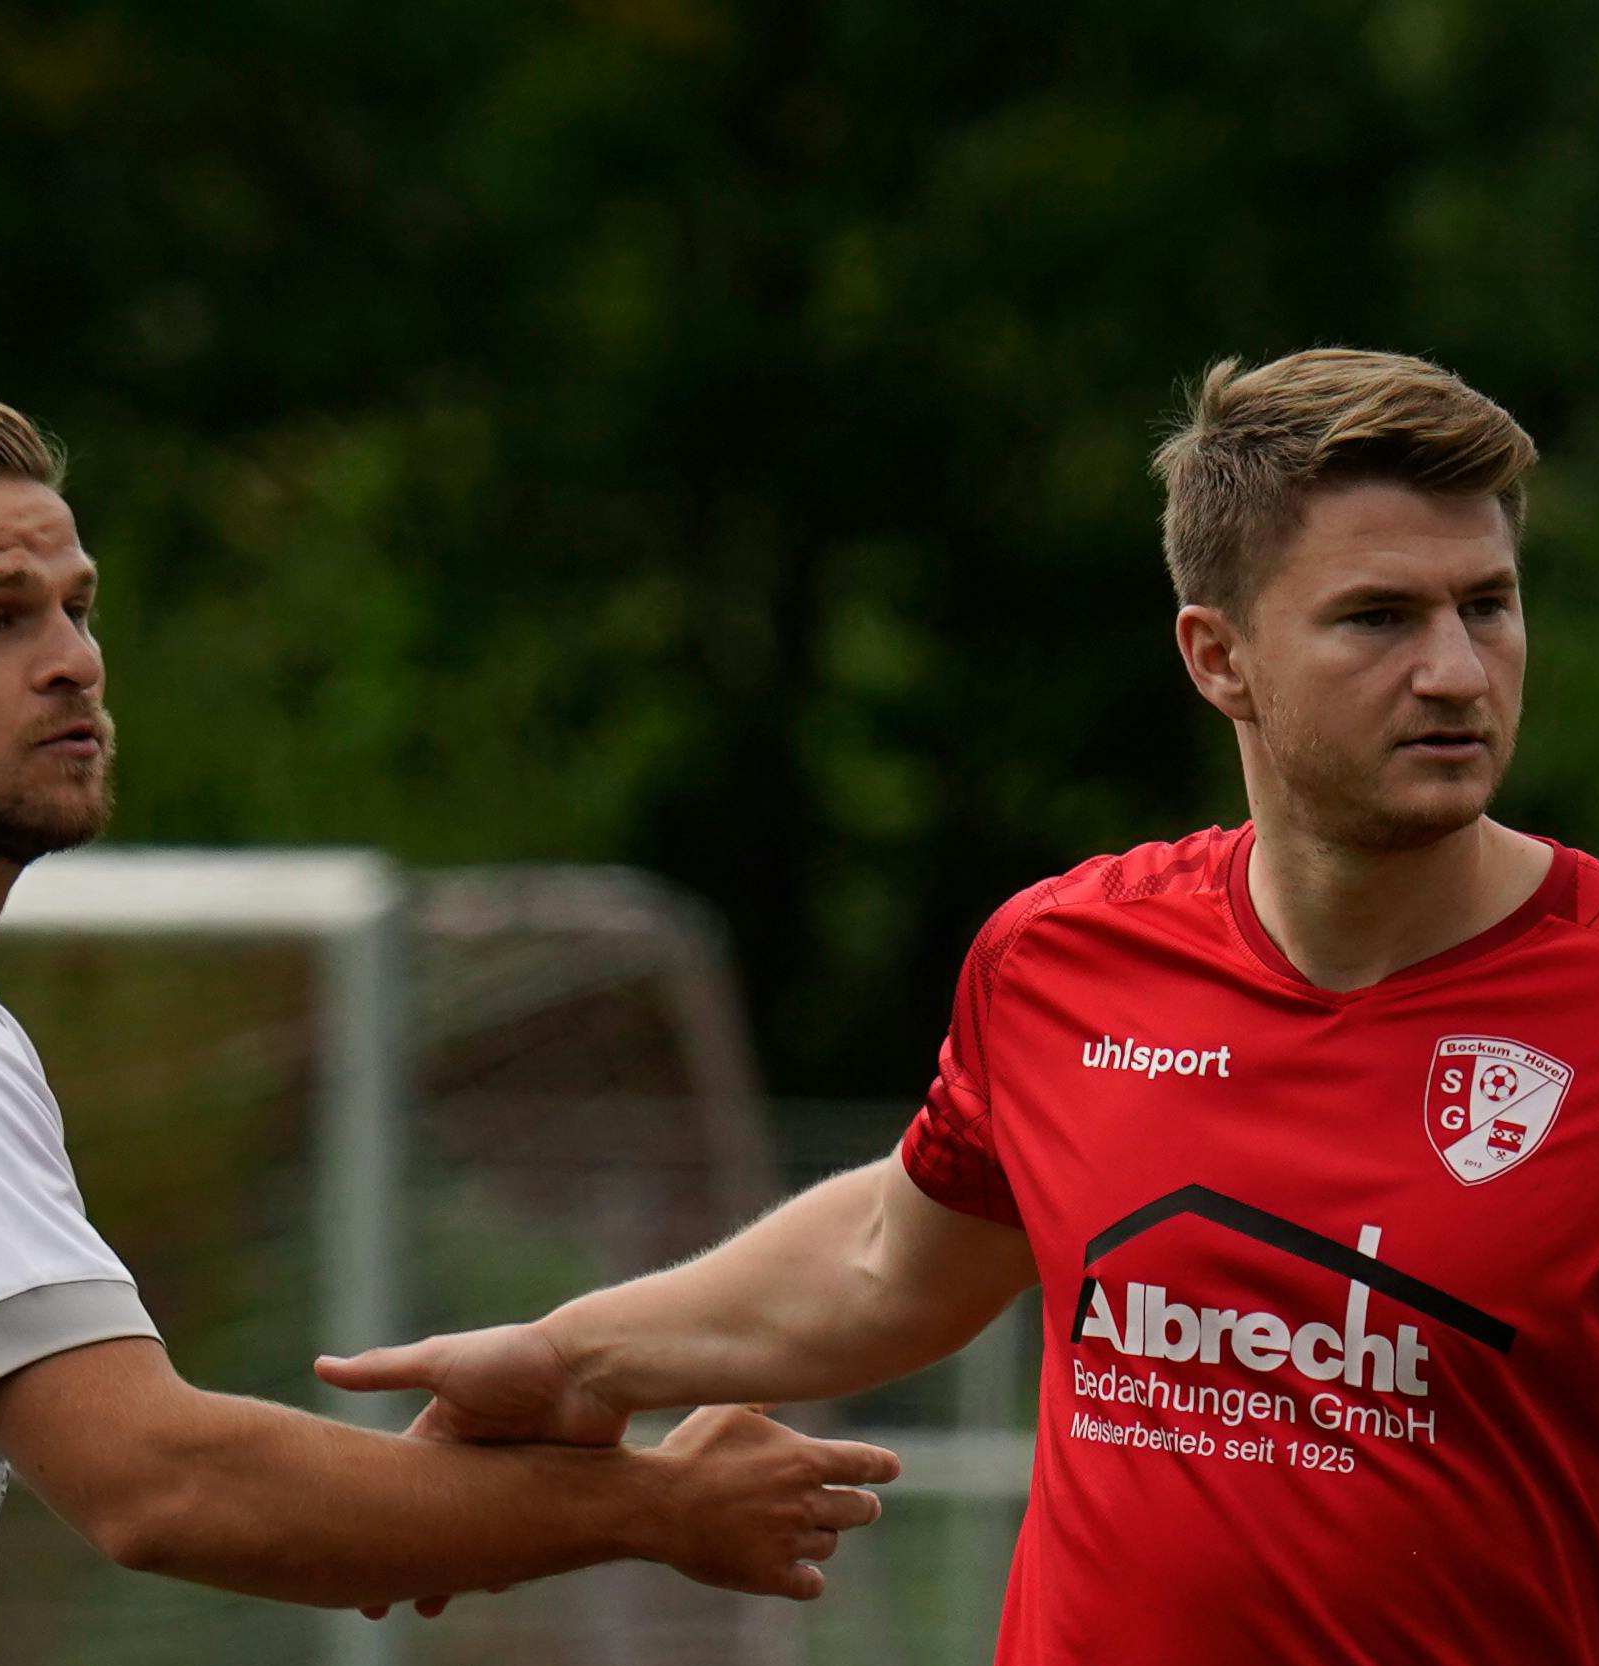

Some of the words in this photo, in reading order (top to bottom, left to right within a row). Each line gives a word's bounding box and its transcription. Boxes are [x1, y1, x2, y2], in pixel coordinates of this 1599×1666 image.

[1082, 1034, 1232, 1080] uhlsport
[1446, 1042, 1511, 1058] Bockum
[1523, 1054, 1566, 1081] Hövel
[1072, 1225, 1429, 1396] Albrecht
[1072, 1359, 1296, 1427] Bedachungen
[1309, 1392, 1436, 1444] GmbH
[1070, 1411, 1216, 1457] Meisterbetrieb
[1223, 1437, 1275, 1465] seit
[1285, 1441, 1355, 1474] 1925
